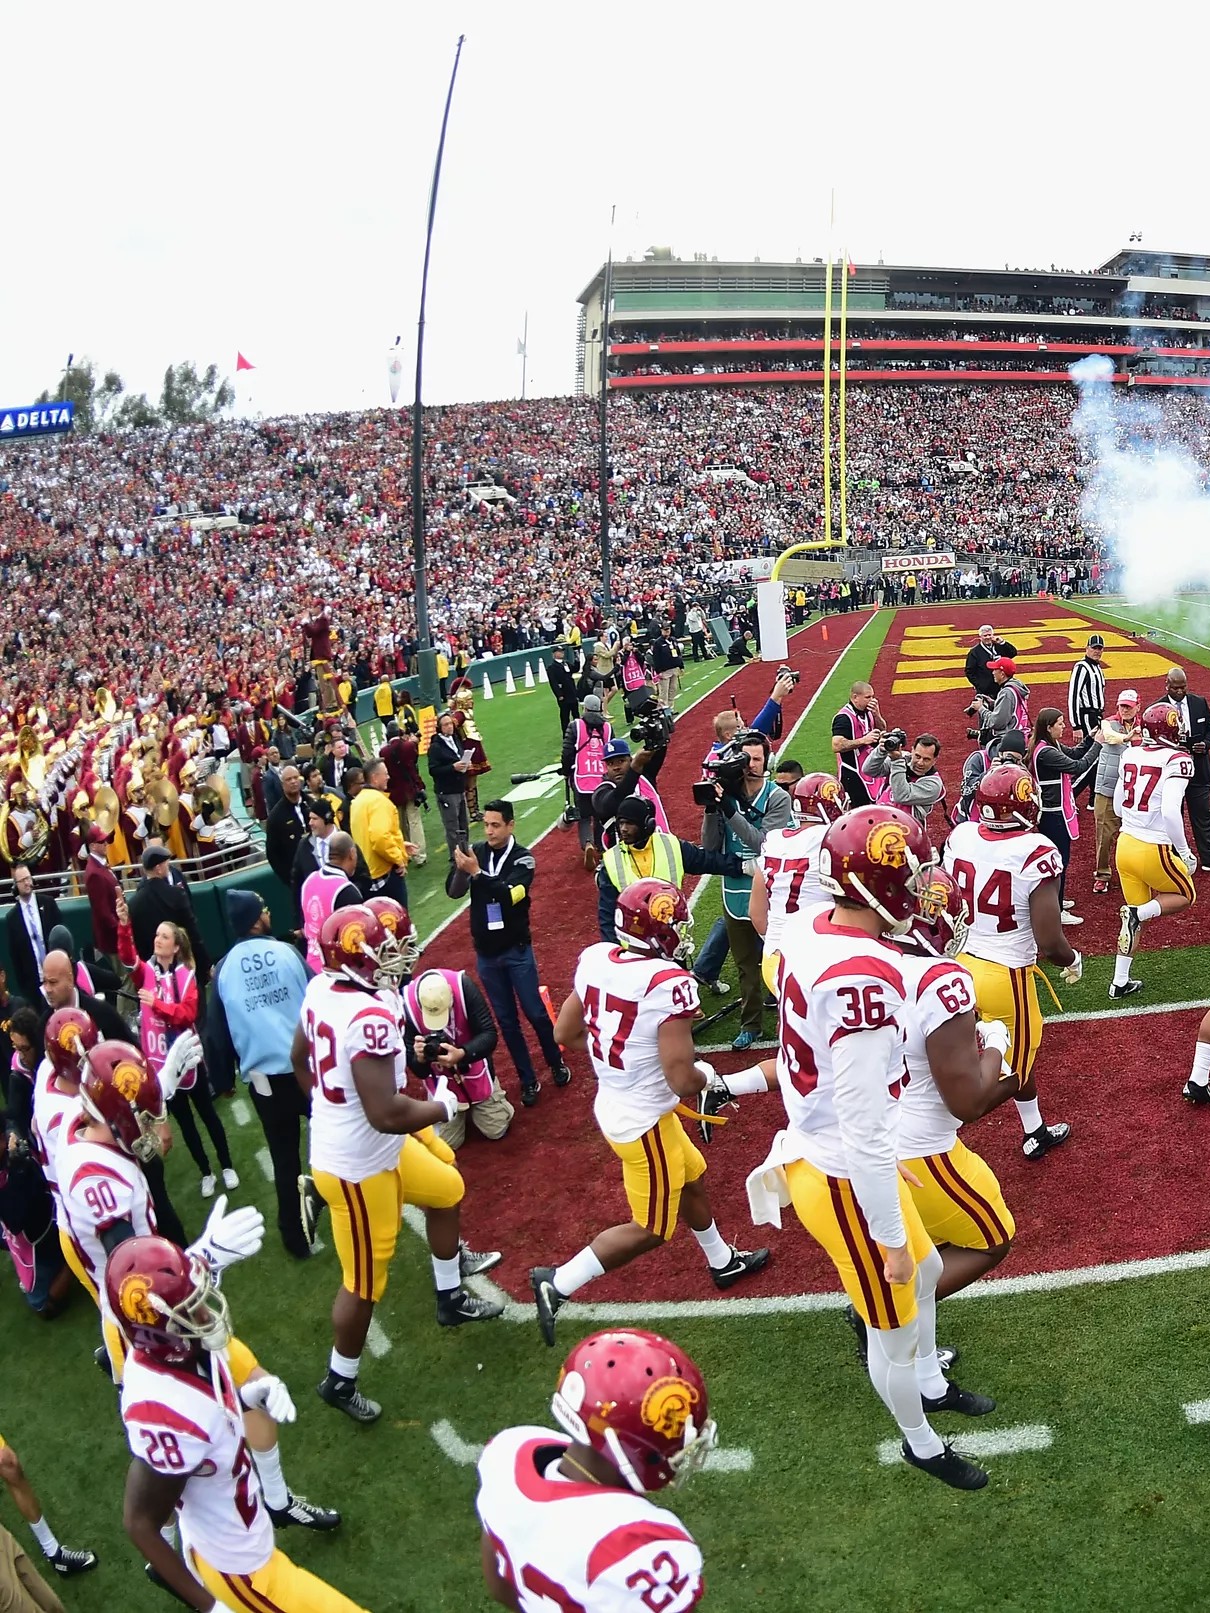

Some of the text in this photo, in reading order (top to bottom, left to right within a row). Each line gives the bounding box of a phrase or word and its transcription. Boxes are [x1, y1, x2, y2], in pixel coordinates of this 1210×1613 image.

[17, 408, 70, 428] DELTA
[884, 555, 952, 568] HONDA
[1180, 761, 1193, 775] 87
[1122, 763, 1162, 812] 87
[764, 856, 810, 914] 77
[953, 858, 1019, 933] 94
[240, 950, 276, 973] CSC
[244, 971, 280, 992] SECURITY
[244, 986, 291, 1013] SUPERVISOR
[672, 979, 694, 1009] 47
[936, 977, 971, 1014] 63
[837, 985, 886, 1027] 36
[363, 1023, 389, 1050] 92
[583, 984, 639, 1071] 47
[84, 1180, 117, 1219] 90
[139, 1428, 185, 1470] 28
[625, 1550, 690, 1613] 22
